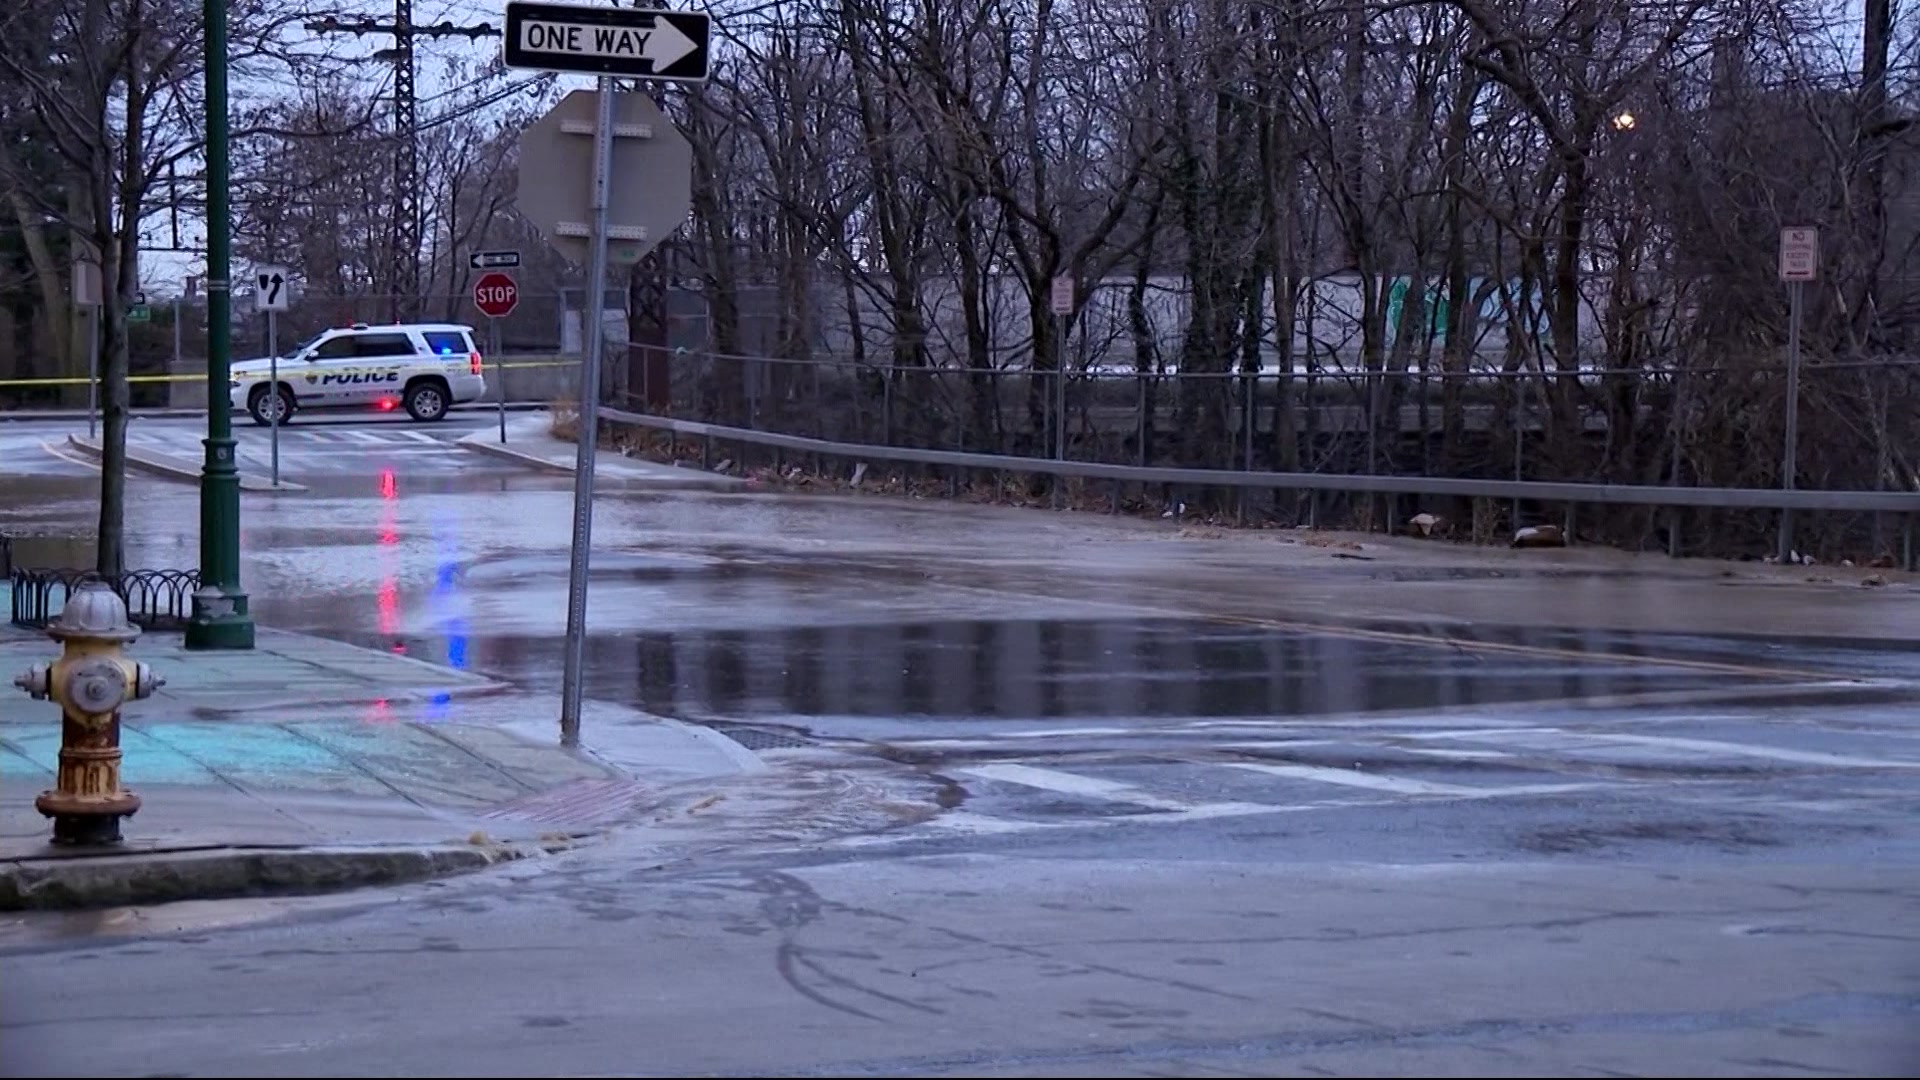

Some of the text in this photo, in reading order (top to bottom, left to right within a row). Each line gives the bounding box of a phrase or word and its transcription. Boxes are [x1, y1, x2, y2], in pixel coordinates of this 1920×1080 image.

[528, 24, 652, 56] ONE WAY
[477, 286, 516, 304] STOP
[322, 366, 400, 385] POLICE
